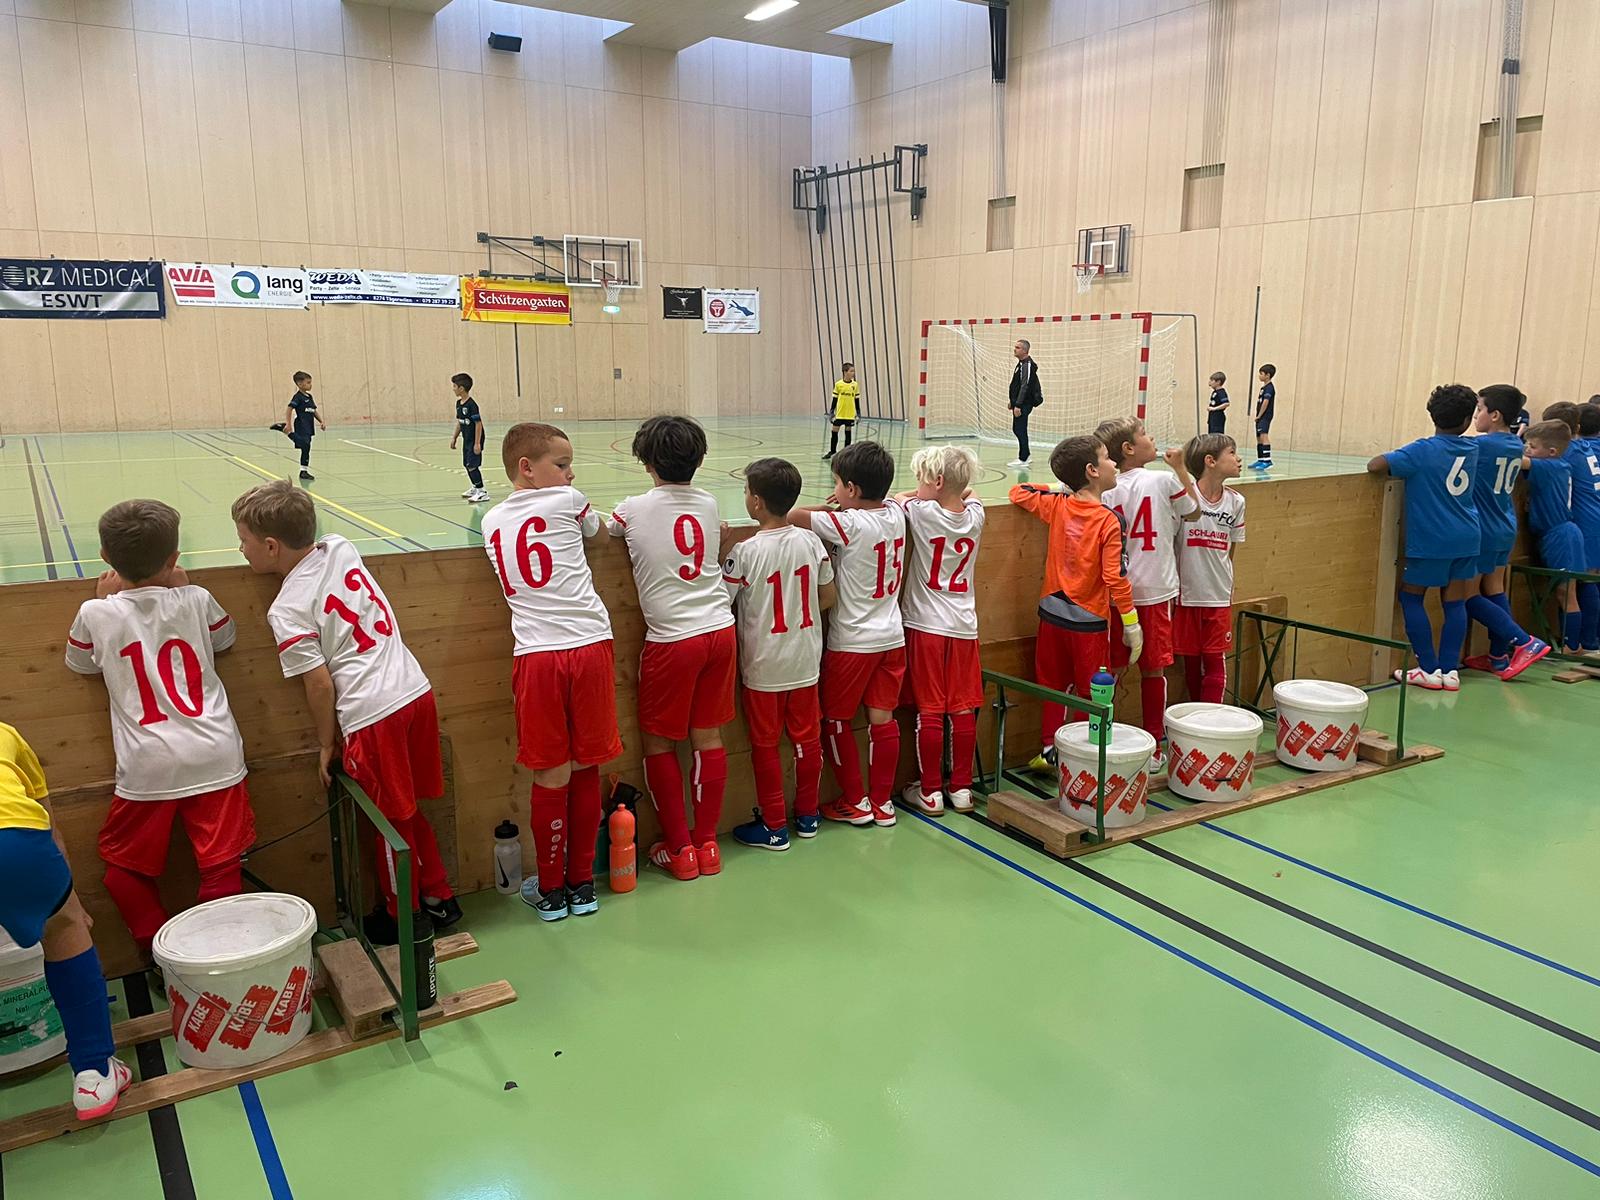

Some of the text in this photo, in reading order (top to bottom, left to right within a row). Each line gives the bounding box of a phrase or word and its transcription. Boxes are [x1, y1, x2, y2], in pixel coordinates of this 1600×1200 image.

[61, 267, 155, 287] MEDICAL
[168, 266, 214, 283] AVIA
[267, 276, 303, 293] lang
[309, 272, 361, 284] WEDA
[41, 293, 103, 308] ESWT
[478, 292, 566, 310] Schützengarten
[1445, 456, 1470, 496] 6
[1493, 457, 1522, 495] 10
[489, 516, 553, 597] 16
[673, 513, 705, 581] 9
[872, 537, 904, 599] 15
[927, 536, 975, 592] 12
[323, 567, 392, 654] 13
[767, 564, 814, 634] 11
[119, 638, 204, 727] 10
[1287, 726, 1304, 744] KABE
[1312, 730, 1331, 749] KABE
[1205, 759, 1225, 779] KABE
[228, 999, 257, 1032] KABE
[274, 982, 297, 1017] KABE
[187, 1003, 210, 1033] KABE
